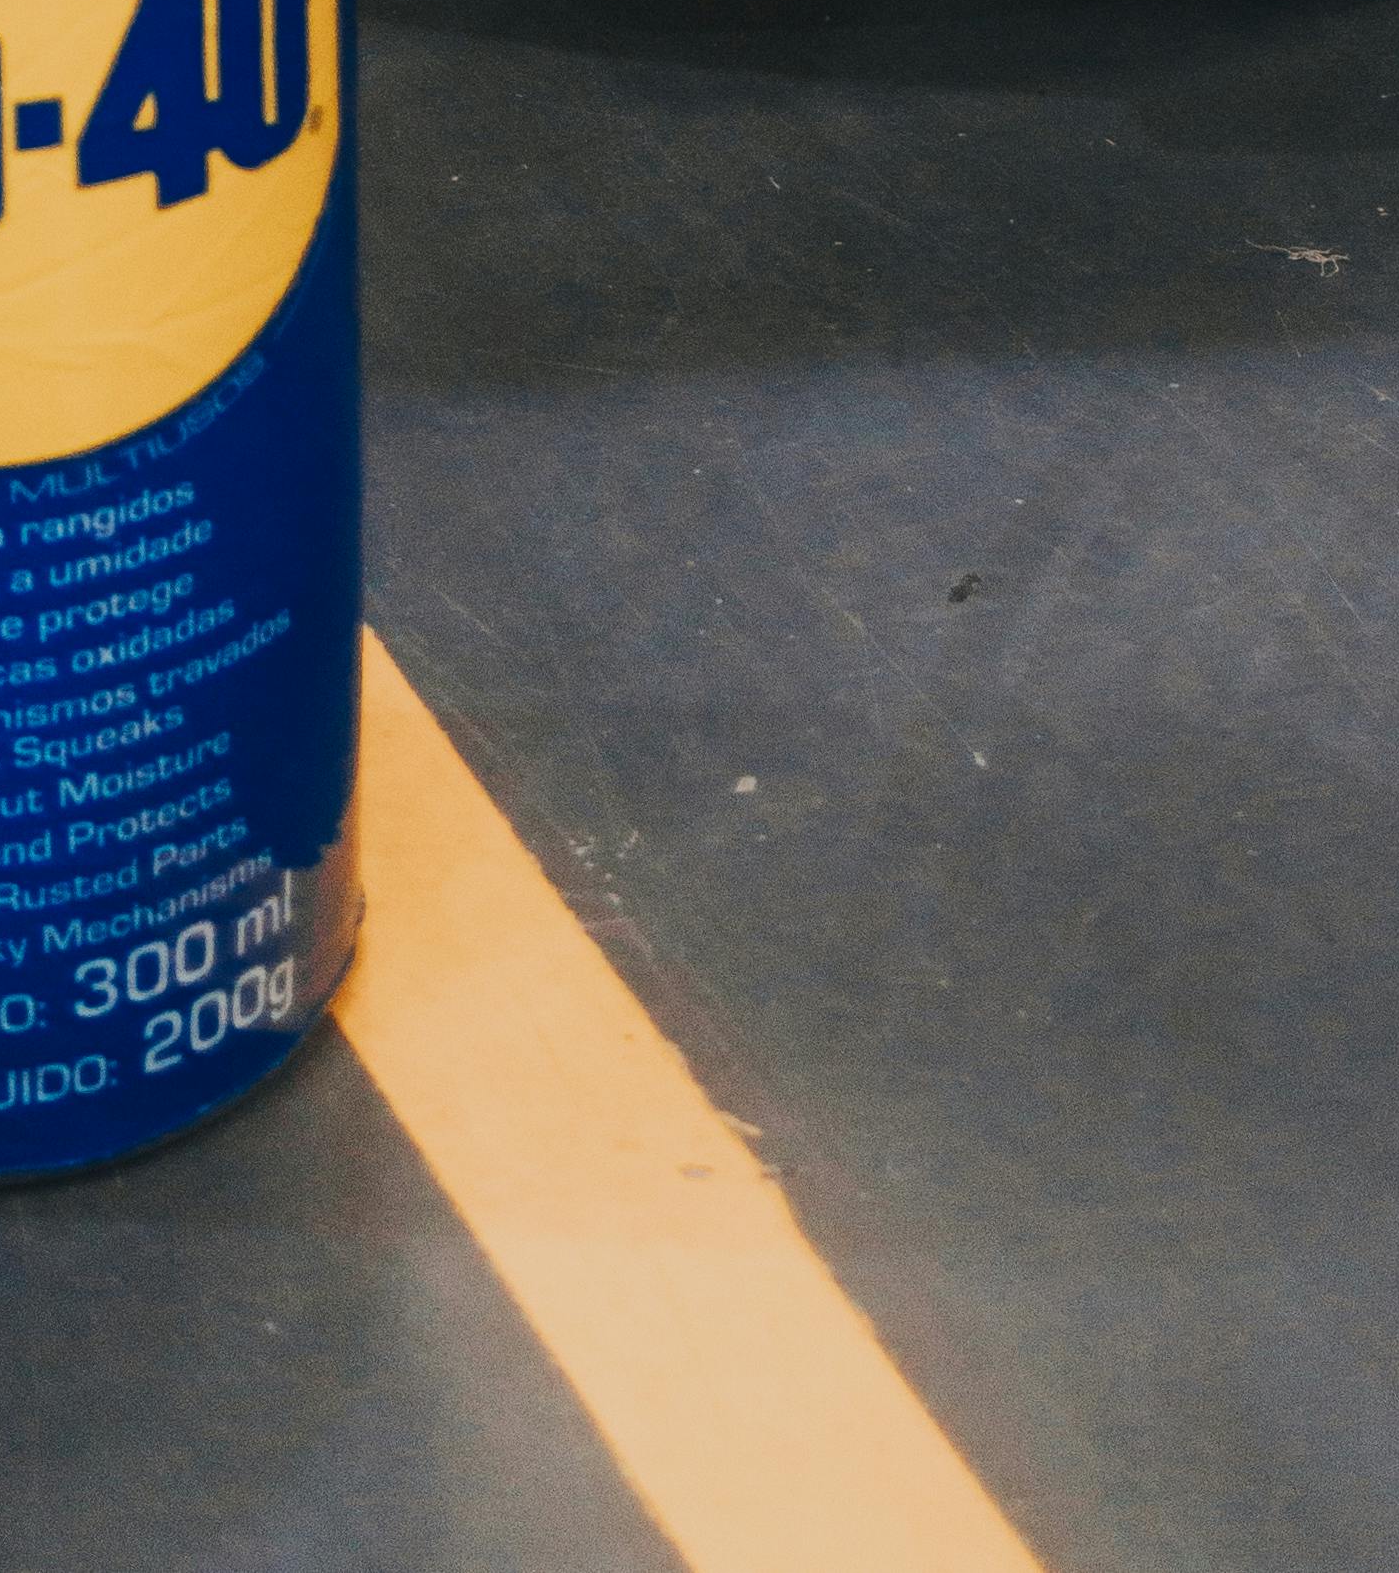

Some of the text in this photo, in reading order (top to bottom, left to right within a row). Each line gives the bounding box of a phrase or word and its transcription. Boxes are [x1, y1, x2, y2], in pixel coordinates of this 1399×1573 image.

[20, 481, 195, 545] rangidos
[10, 569, 34, 594] a
[49, 519, 212, 587] umidade
[0, 616, 24, 641] e
[38, 573, 194, 643] protege
[71, 598, 235, 674] oxidadas
[149, 608, 291, 697] travados
[13, 705, 184, 770] Squeaks
[57, 731, 231, 808] Moisture
[66, 778, 233, 855] Protects
[152, 816, 249, 876] Parts
[41, 847, 273, 954] Mechanisms
[73, 919, 216, 1019] 300
[237, 868, 293, 957] ml
[142, 954, 294, 1074] 200g
